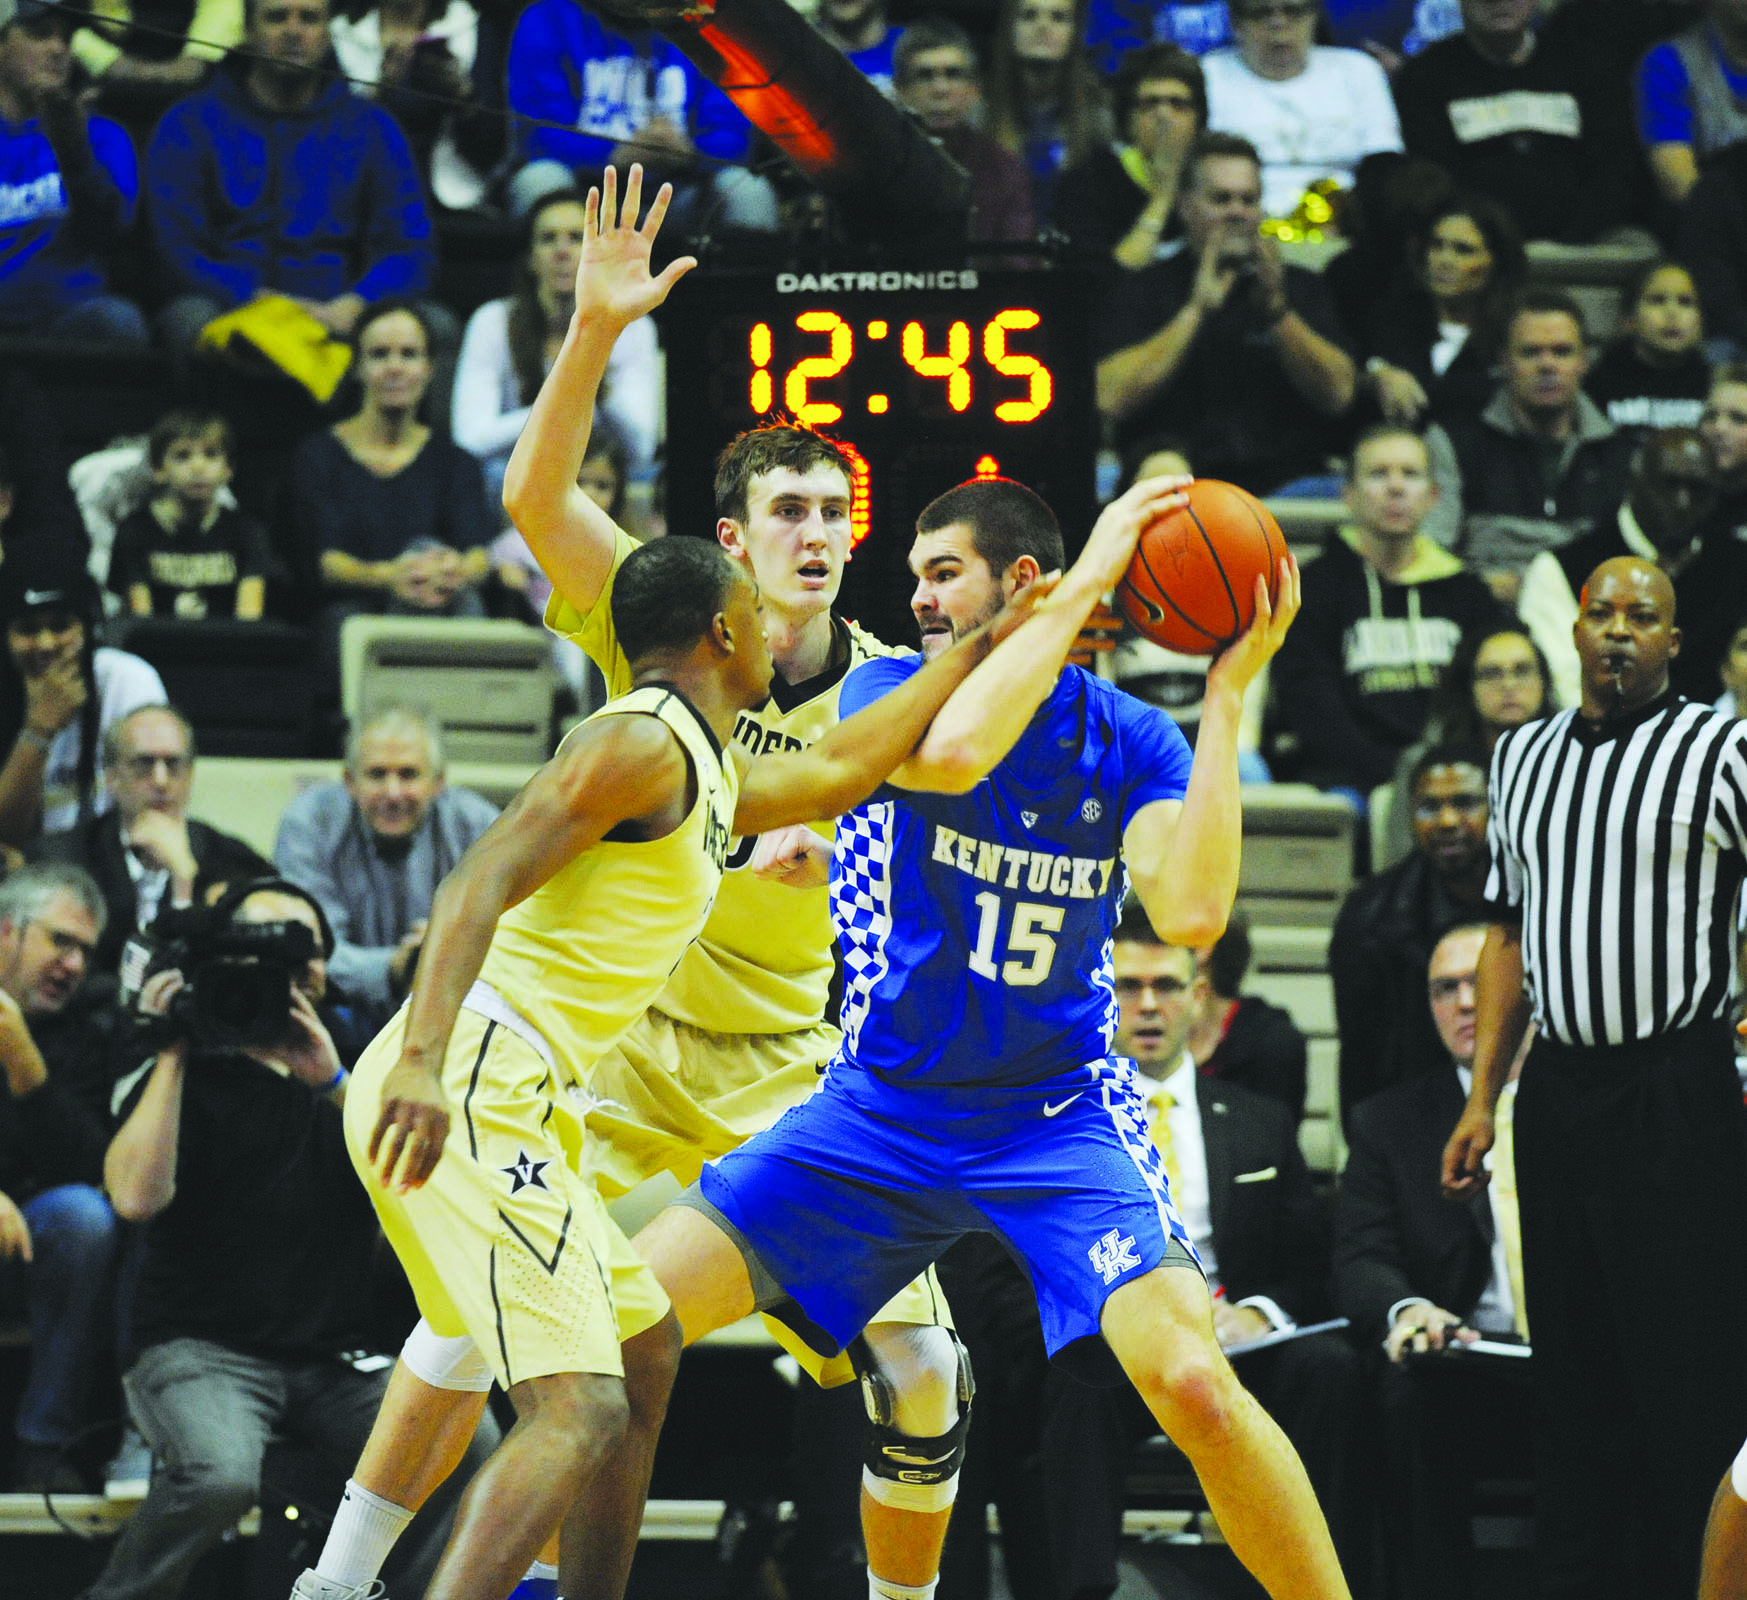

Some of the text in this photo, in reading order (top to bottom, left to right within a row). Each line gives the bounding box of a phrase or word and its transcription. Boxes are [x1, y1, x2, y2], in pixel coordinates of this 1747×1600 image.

[776, 271, 978, 293] DAKTRONICS
[750, 309, 1053, 423] 12:45
[1082, 799, 1101, 822] SEC
[932, 824, 1115, 899] KENTUCKY
[968, 891, 1066, 986] 15
